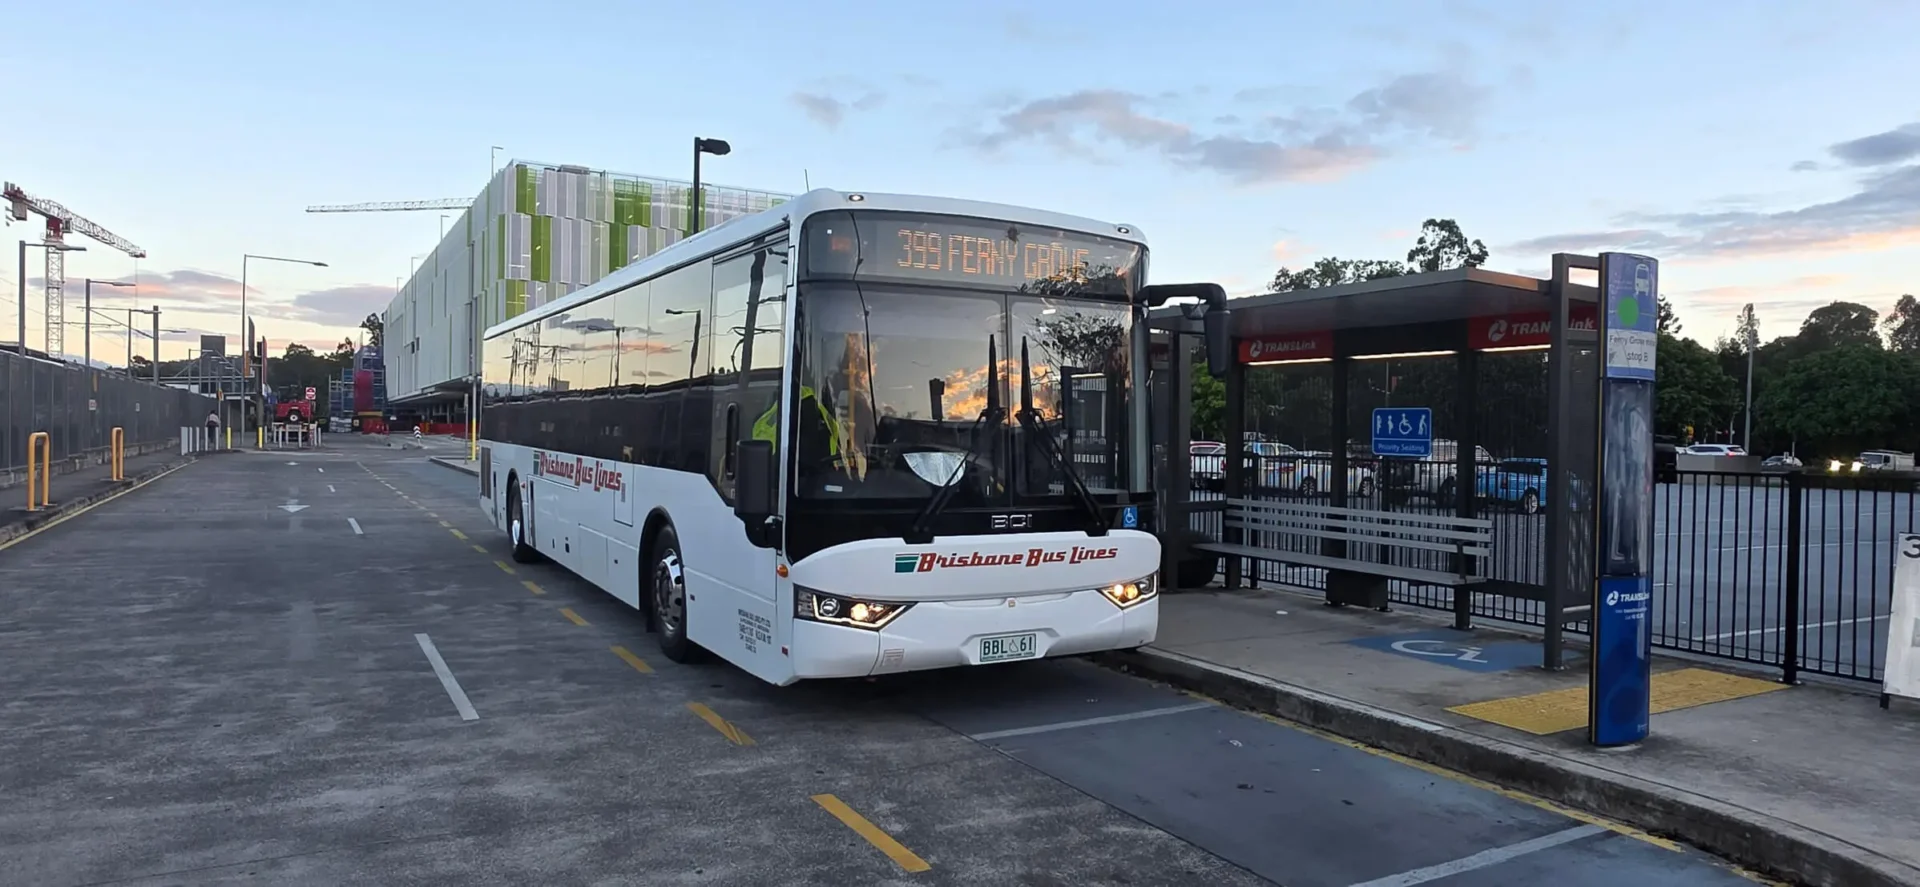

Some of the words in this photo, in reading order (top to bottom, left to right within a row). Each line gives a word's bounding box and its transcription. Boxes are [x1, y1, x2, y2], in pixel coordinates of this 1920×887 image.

[897, 229, 942, 270] 399
[948, 234, 1019, 277] FERNY
[1024, 242, 1090, 284] GROVE
[1627, 352, 1643, 364] stop
[540, 451, 575, 479] Brisbane
[574, 457, 593, 486] Bus
[594, 460, 622, 492] Lines
[917, 552, 1023, 572] Brisbane
[1025, 548, 1067, 567] Bus
[1068, 545, 1119, 565] Lines
[983, 638, 1008, 656] BBL
[1019, 636, 1033, 652] 61
